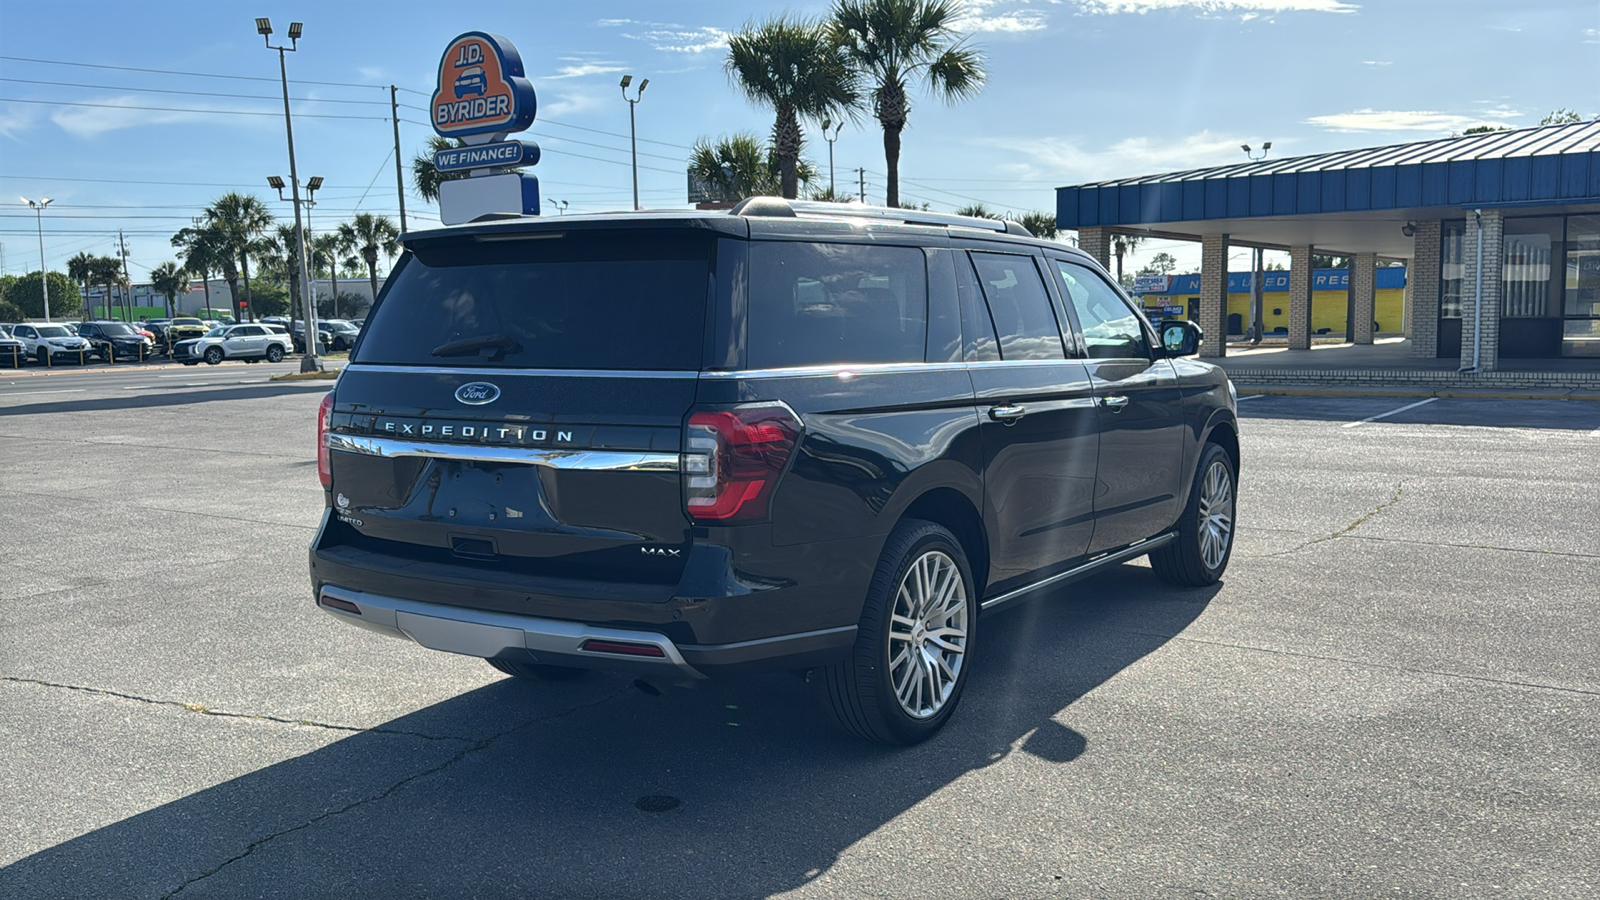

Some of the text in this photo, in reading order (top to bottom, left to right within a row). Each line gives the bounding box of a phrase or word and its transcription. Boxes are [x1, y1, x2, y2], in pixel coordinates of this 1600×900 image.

[455, 44, 483, 66] J.D.
[437, 95, 509, 123] BYRIDER
[438, 146, 517, 166] WE FINANCE!
[462, 386, 489, 399] Ford
[385, 422, 572, 442] EXPEDITION
[337, 514, 363, 526] LIMITED
[641, 547, 681, 558] MAX
